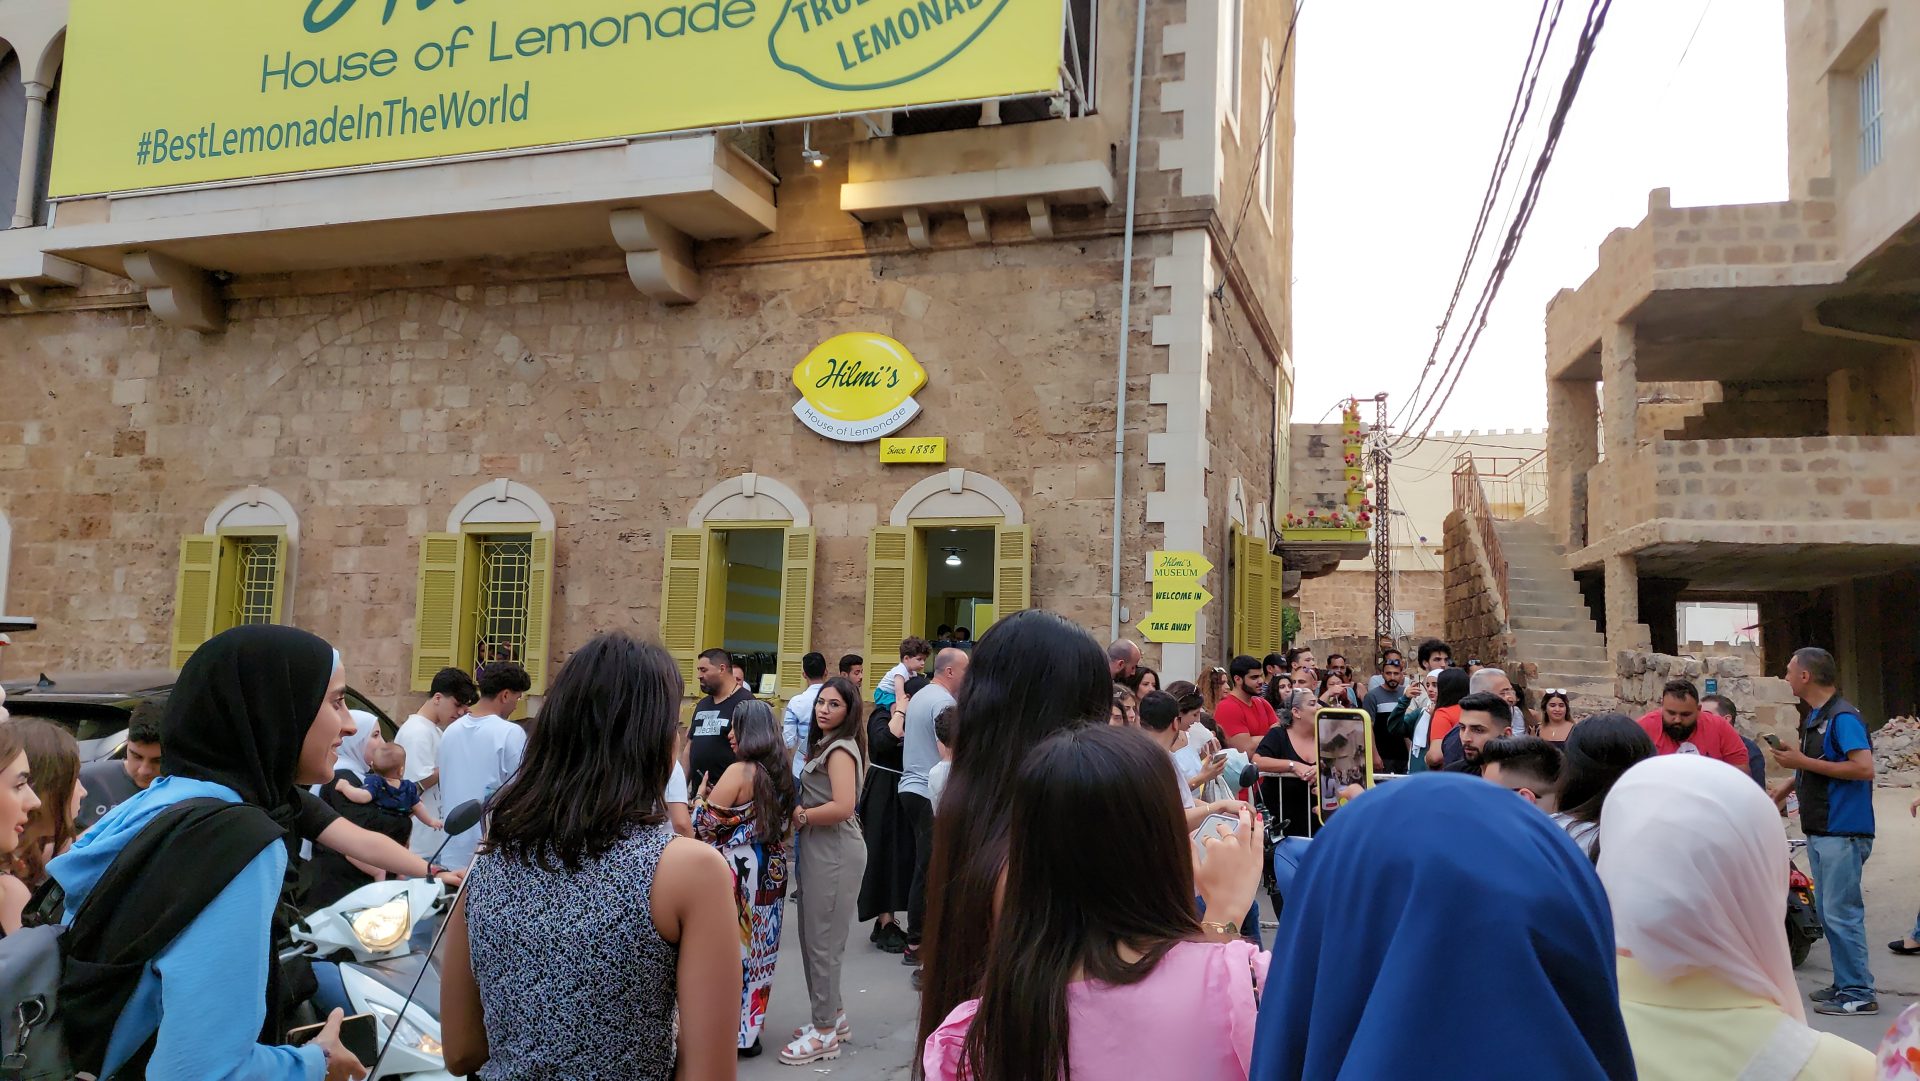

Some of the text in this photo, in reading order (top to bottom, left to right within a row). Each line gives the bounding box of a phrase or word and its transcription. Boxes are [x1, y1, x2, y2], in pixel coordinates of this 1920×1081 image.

[792, 0, 870, 32] TRU
[261, 49, 397, 93] House
[414, 25, 474, 71] of
[489, 0, 756, 62] Lemonade
[136, 81, 530, 166] #BestLemonadeInTheWorld
[815, 358, 899, 389] Hilmi's
[804, 407, 906, 436] House of Lemonade
[887, 444, 937, 455] Since 1888
[1160, 556, 1191, 567] Hilmi's
[1154, 568, 1198, 576] MUSEUM
[1155, 592, 1202, 600] WELCOME IN
[1150, 622, 1192, 631] TAKE AWAY
